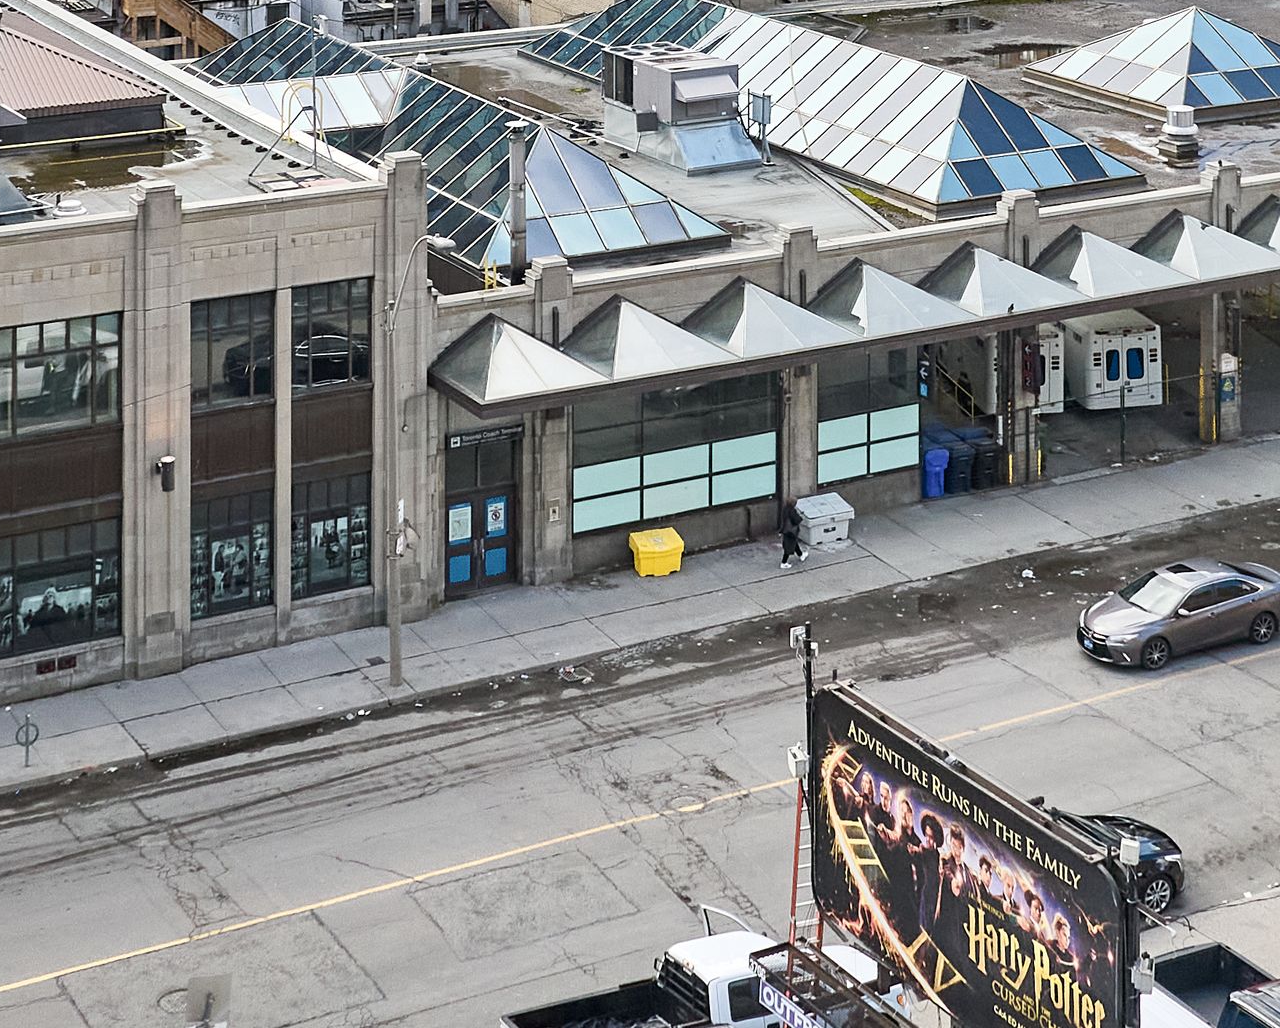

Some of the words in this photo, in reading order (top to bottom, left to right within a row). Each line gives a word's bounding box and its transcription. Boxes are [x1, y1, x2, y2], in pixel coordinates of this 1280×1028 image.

[483, 430, 500, 438] Coach
[847, 720, 928, 789] ADVENTURE
[931, 773, 971, 816] RUNS
[972, 804, 990, 830] IN
[992, 817, 1022, 853] THE
[1025, 836, 1082, 890] FAMILY
[963, 904, 1032, 990] Harry
[1031, 939, 1106, 1028] Potter
[762, 985, 821, 1028] OUTFR
[991, 979, 1037, 1022] CURSED
[1022, 993, 1035, 1006] AND
